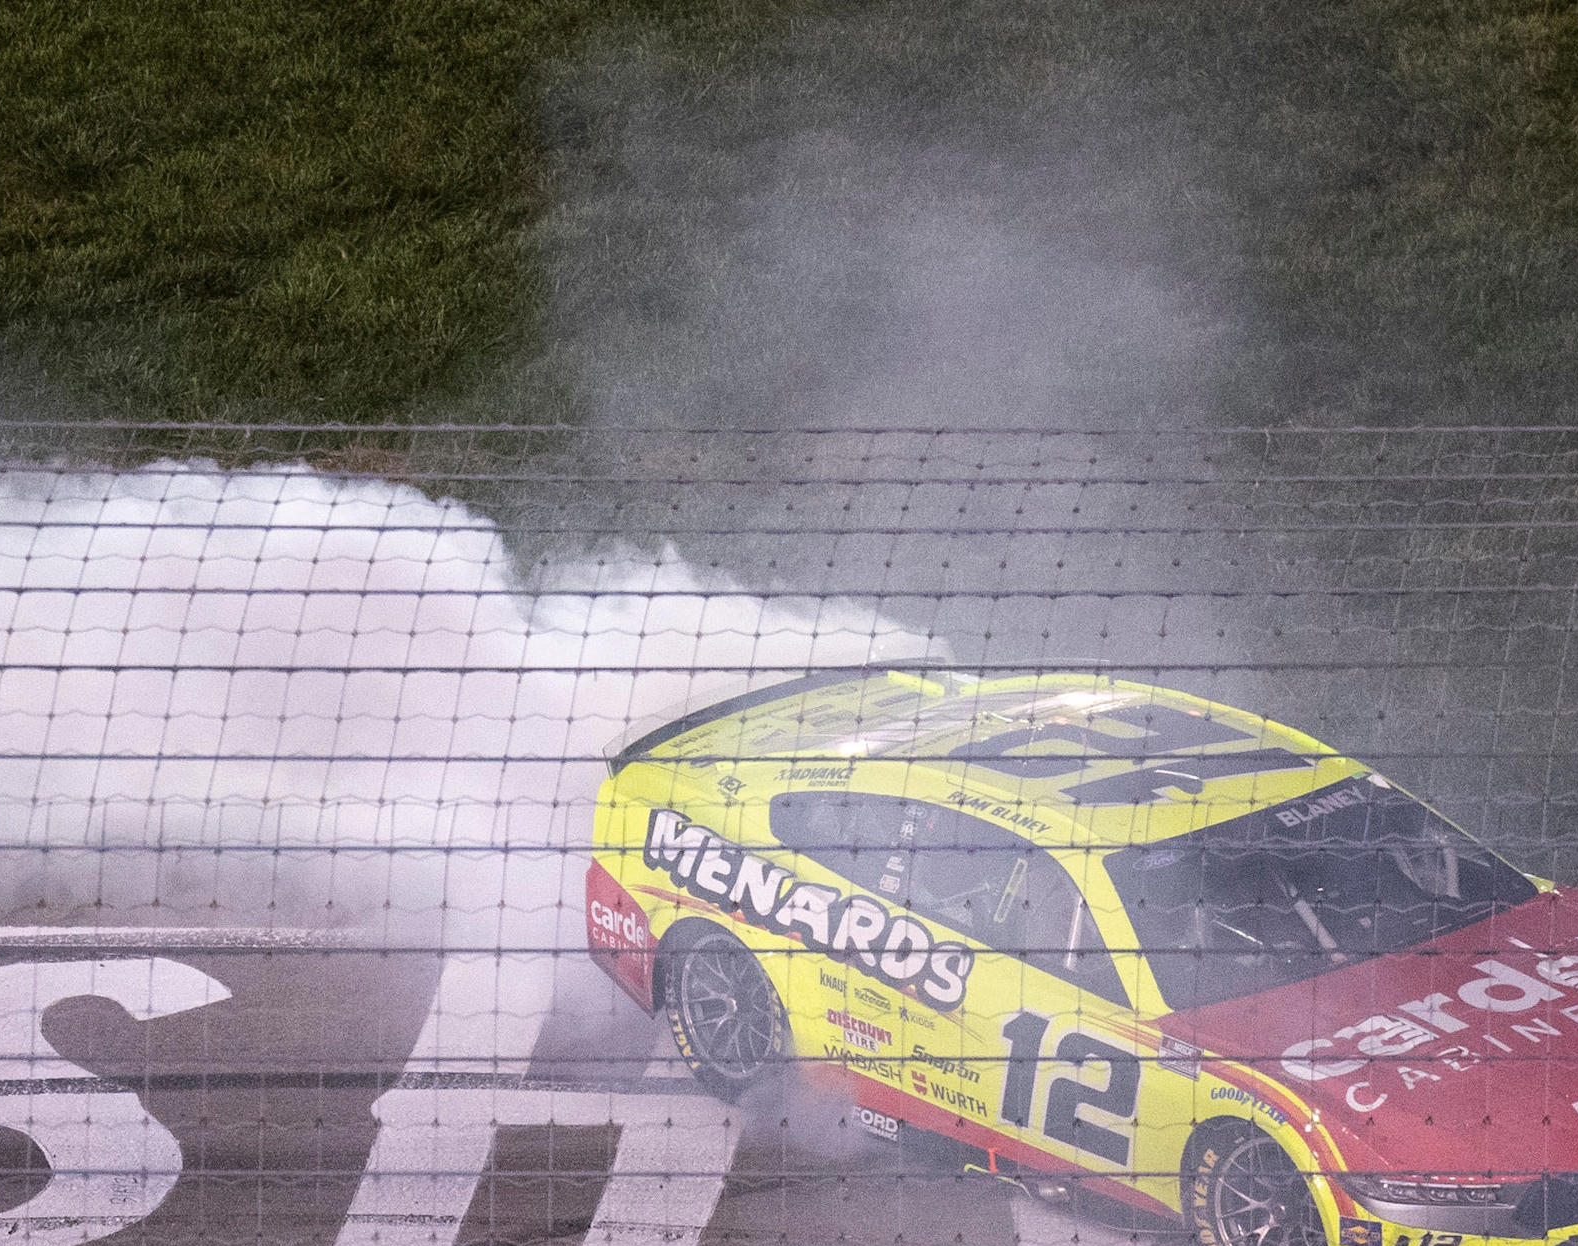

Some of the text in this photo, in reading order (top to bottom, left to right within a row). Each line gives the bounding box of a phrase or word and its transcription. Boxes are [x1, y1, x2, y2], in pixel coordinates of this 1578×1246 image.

[788, 766, 857, 781] ADVANCE
[947, 790, 1053, 834] RYAN BLANEY
[1275, 786, 1366, 828] BLANEY
[646, 810, 974, 1006] MENARDS
[820, 967, 848, 998] KNAUF
[827, 1008, 893, 1046] DISCOUNT
[846, 1031, 879, 1051] TIRE
[823, 1043, 903, 1084] WABASH
[912, 1044, 981, 1084] Snap-on
[999, 1011, 1141, 1167] 12
[1210, 1086, 1288, 1126] GOODYEAR
[853, 1105, 899, 1133] FORD
